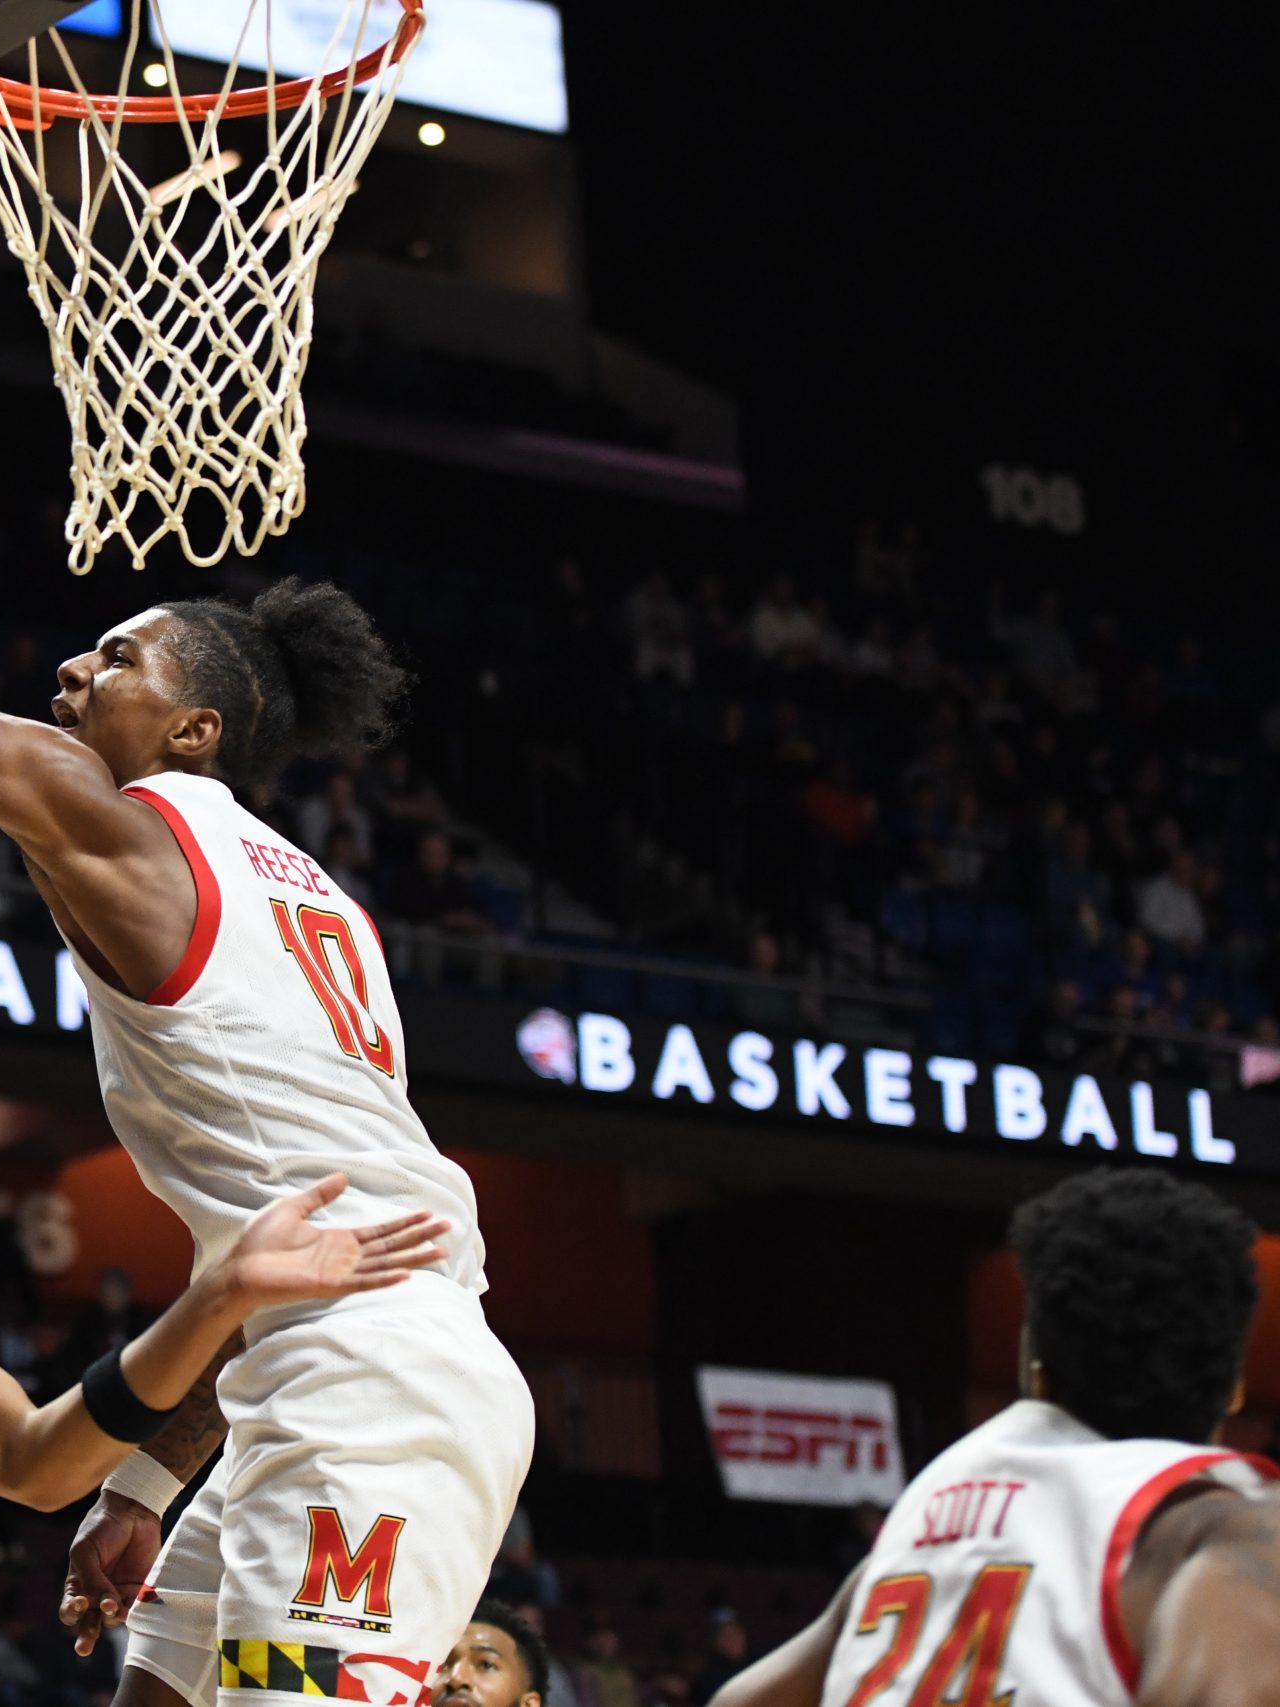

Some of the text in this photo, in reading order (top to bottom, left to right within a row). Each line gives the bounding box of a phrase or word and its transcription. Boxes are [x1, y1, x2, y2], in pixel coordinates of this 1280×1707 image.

[239, 836, 330, 897] REESE
[268, 897, 395, 1079] 10
[576, 1012, 1238, 1165] BASKETBALL
[712, 1402, 888, 1472] ESPN
[291, 1505, 407, 1619] M
[913, 1479, 1028, 1550] SCOTT
[845, 1562, 1034, 1707] 24
